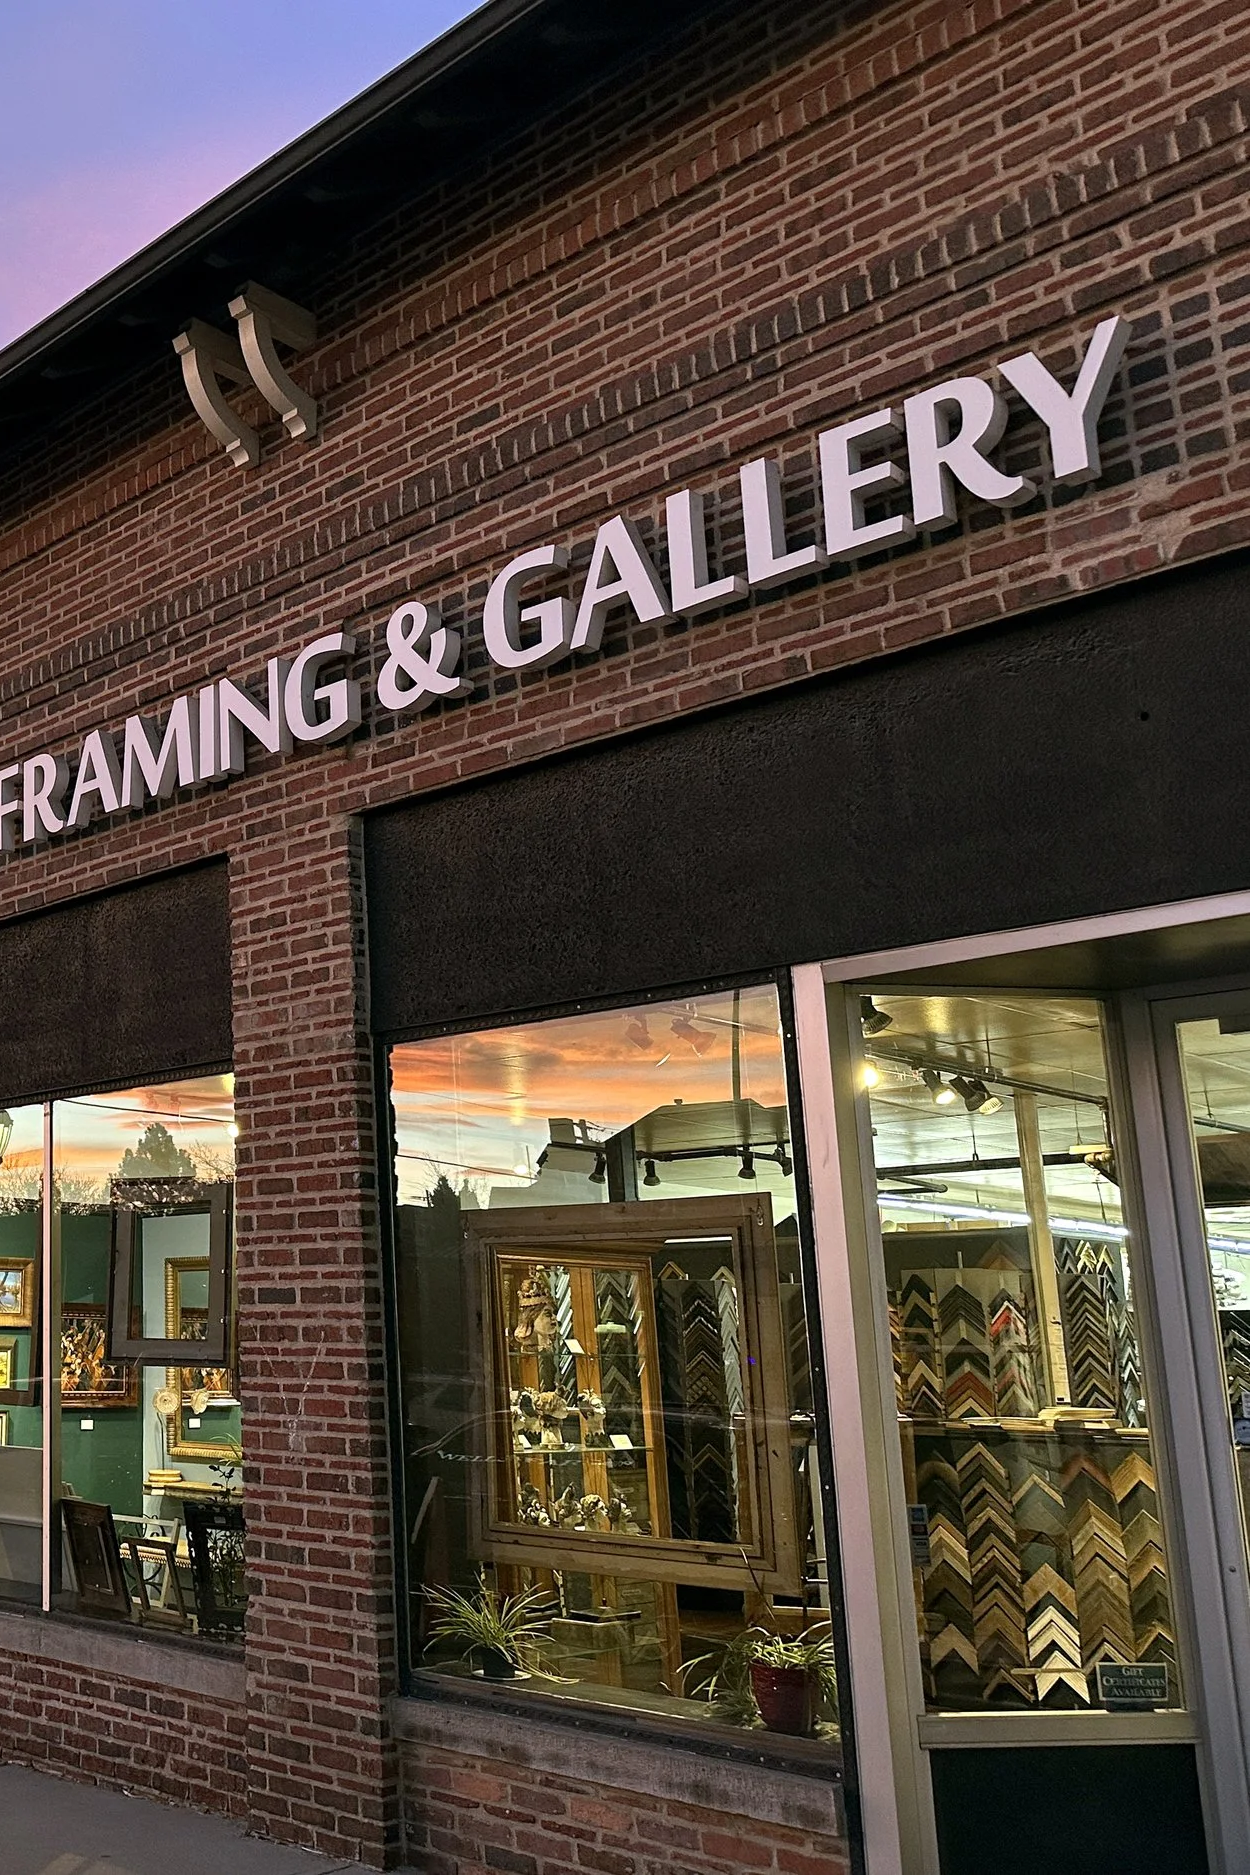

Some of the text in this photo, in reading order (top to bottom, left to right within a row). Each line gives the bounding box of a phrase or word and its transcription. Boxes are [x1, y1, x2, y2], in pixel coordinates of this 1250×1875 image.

[376, 600, 466, 711] &
[482, 314, 1126, 669] GALLERY
[1121, 1666, 1144, 1676] GIFT
